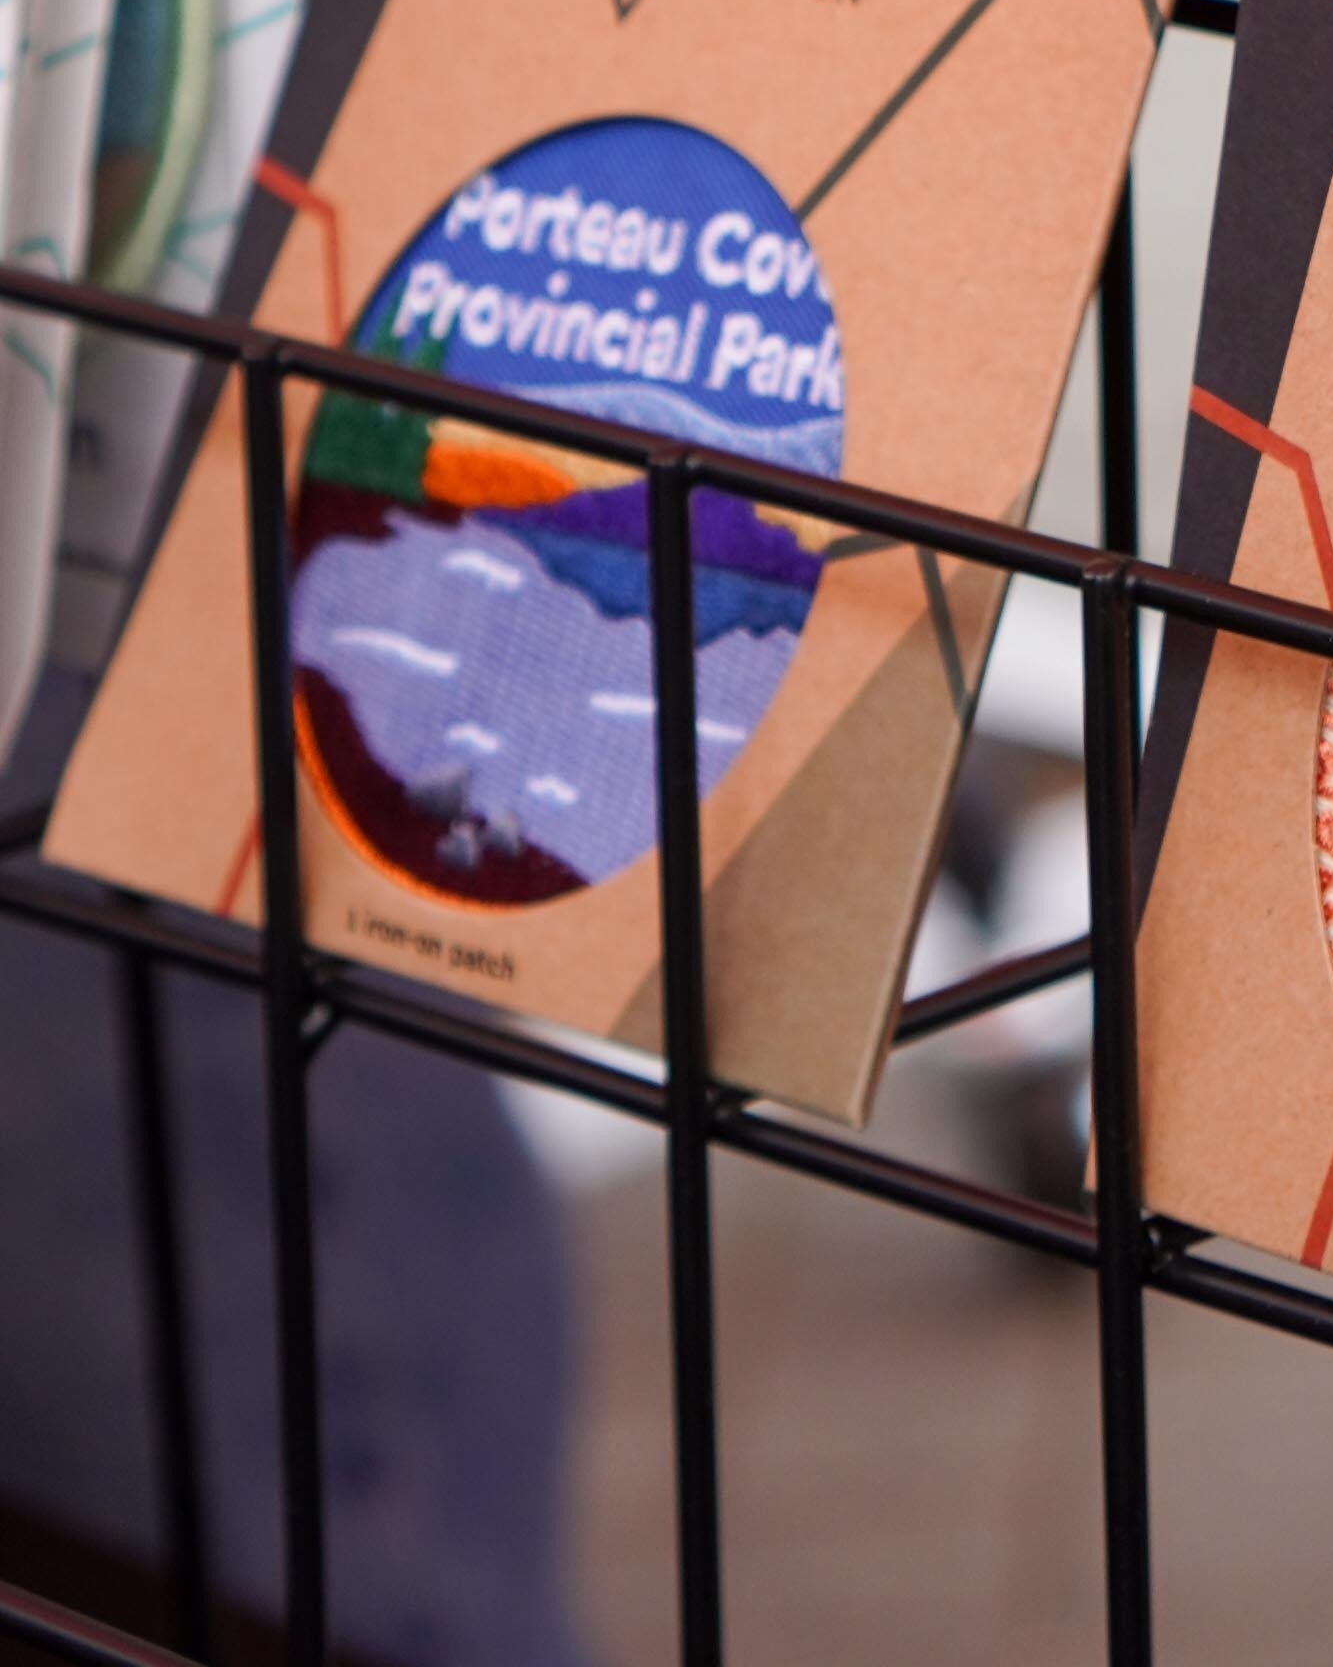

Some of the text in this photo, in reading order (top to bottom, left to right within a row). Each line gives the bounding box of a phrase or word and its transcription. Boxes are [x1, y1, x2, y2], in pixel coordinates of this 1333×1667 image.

[445, 172, 687, 277] Porteau
[393, 262, 845, 410] Provincial Park
